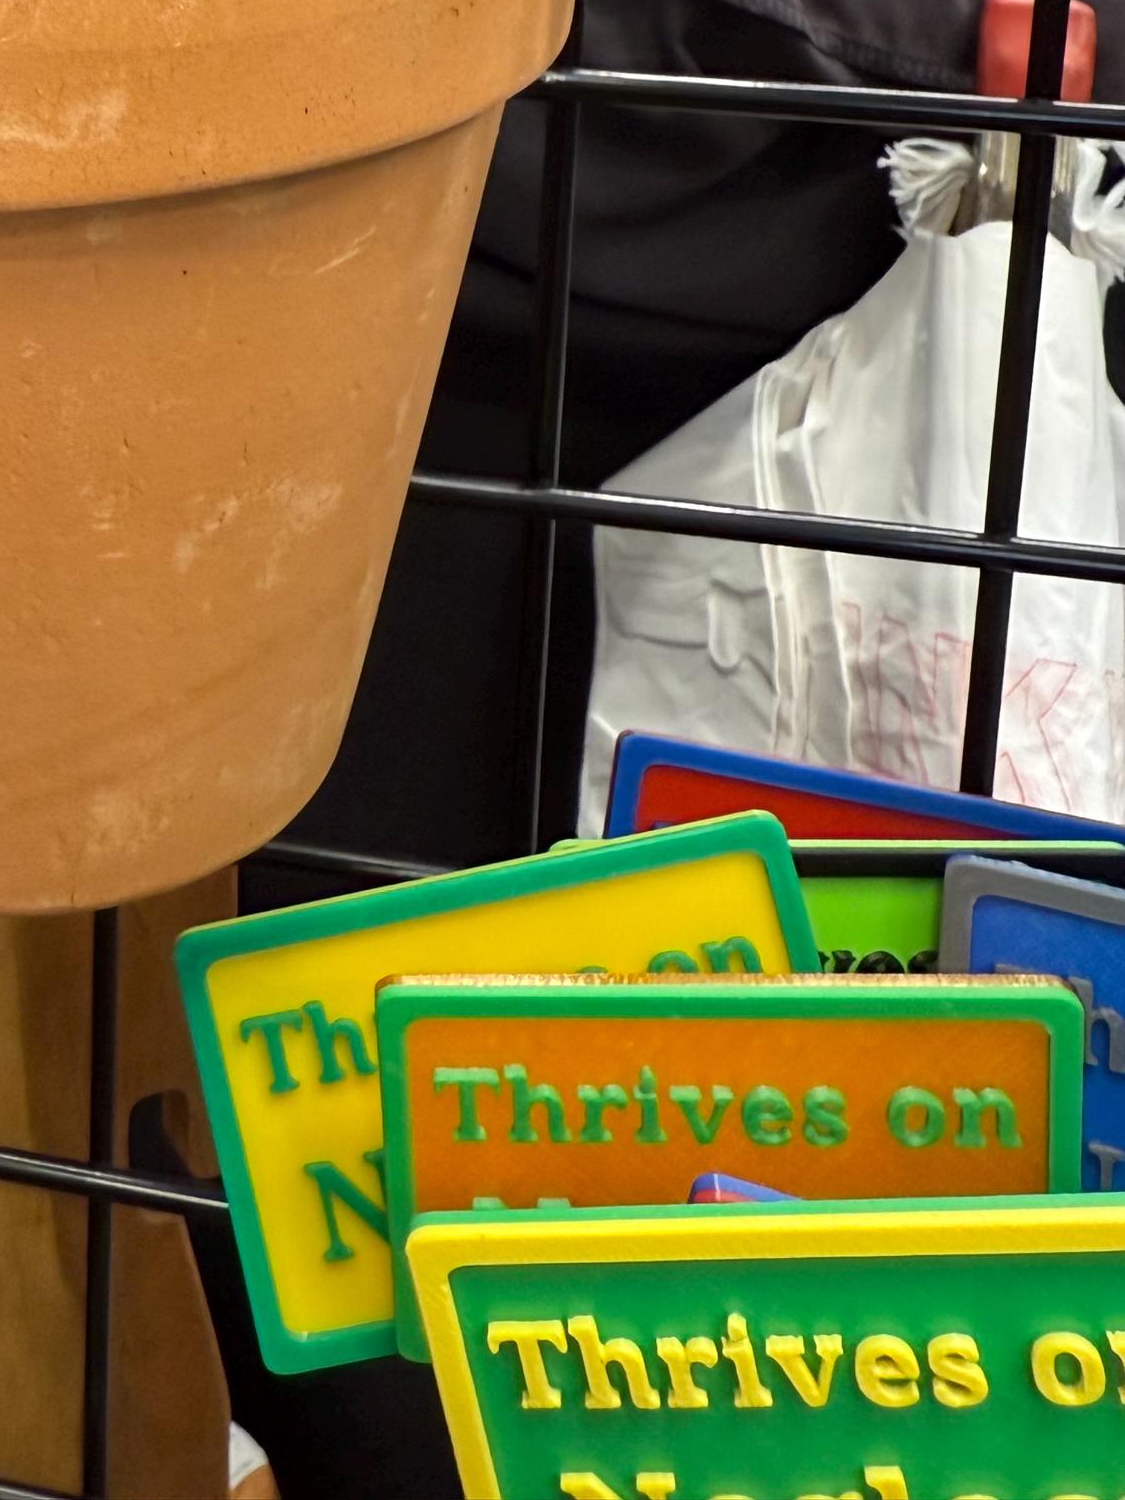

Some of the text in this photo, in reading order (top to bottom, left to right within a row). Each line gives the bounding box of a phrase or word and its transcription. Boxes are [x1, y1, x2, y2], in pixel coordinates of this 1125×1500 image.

[433, 1063, 1023, 1148] Thrives on
[486, 1312, 1125, 1409] Thrives o
